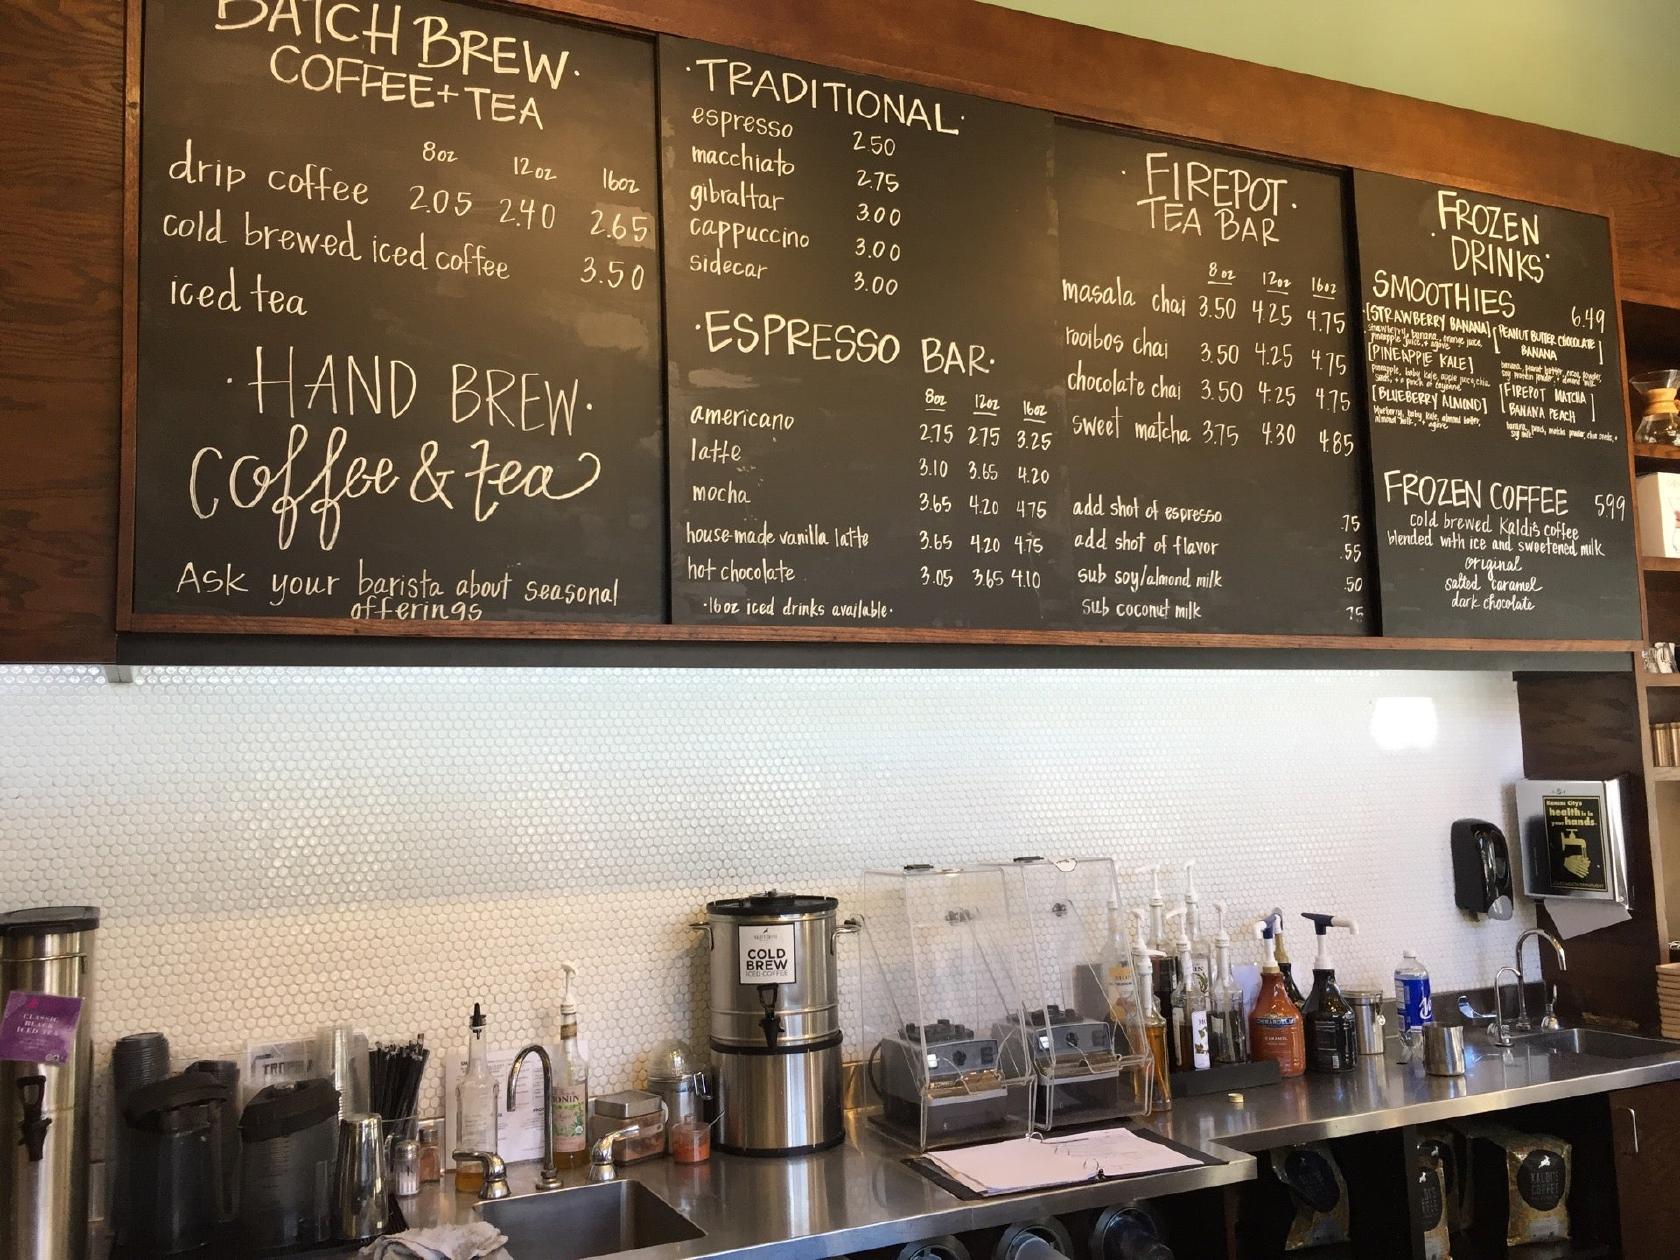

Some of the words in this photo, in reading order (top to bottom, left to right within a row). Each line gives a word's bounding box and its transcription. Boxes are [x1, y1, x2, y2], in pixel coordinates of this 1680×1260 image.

[413, 16, 569, 90] BREW
[465, 87, 543, 129] TEA
[696, 58, 959, 135] TRADITIONAL
[692, 106, 794, 138] espresso
[853, 131, 896, 157] 2.50
[422, 142, 458, 163] 8oz
[514, 157, 557, 180] 12oz
[603, 168, 640, 192] 16oz
[692, 142, 795, 177] macchiato
[857, 170, 900, 193] 2.75
[1146, 152, 1288, 216] FIREPOT
[168, 139, 246, 191] drip
[268, 164, 369, 204] coffee
[409, 185, 473, 216] 2.05
[499, 198, 556, 230] 2.40
[590, 210, 648, 242] 2.65
[689, 178, 785, 211] gibraltar
[856, 203, 901, 226] 3.00
[690, 216, 810, 249] cappuccino
[855, 238, 901, 262] 3.00
[1137, 196, 1202, 236] TEA
[1214, 208, 1279, 246] BAR
[1438, 190, 1539, 245] FROZEN
[163, 209, 226, 244] cold
[245, 211, 361, 261] brewed
[373, 233, 428, 270] iced
[436, 243, 510, 279] coffee
[580, 258, 645, 290] 3.50
[690, 248, 768, 280] sidecar
[853, 271, 898, 296] 3.00
[1451, 235, 1544, 284] DRINKS
[171, 267, 241, 312] iced
[250, 274, 307, 316] tea
[1062, 276, 1136, 307] masala
[1152, 284, 1186, 316] chai
[1199, 295, 1237, 319] 3.50
[1307, 309, 1345, 334] 4.75
[1372, 269, 1515, 318] SMOOTHIES
[1571, 306, 1605, 334] 6.49
[705, 310, 900, 364] ESPRESSO
[922, 338, 990, 376] BAR
[1066, 324, 1124, 352] rooibos
[1133, 326, 1168, 359] chai
[1201, 344, 1239, 365] 3.50
[1312, 349, 1346, 377] 4.75
[1530, 330, 1556, 346] BUTTER
[248, 346, 417, 418] HAND
[452, 363, 579, 436] BREW
[925, 388, 947, 406] 8oz
[1023, 400, 1047, 417] 16oz
[1068, 359, 1145, 396] chocolate
[1151, 374, 1181, 400] chai
[1200, 380, 1243, 403] 3.50
[690, 405, 794, 430] americano
[1016, 430, 1053, 451] 3.25
[1072, 406, 1123, 439] sweet
[1135, 411, 1192, 444] matcha
[1202, 420, 1239, 446] 3.75
[1319, 429, 1354, 457] 4.85
[410, 441, 455, 509] &
[691, 438, 742, 464] latte
[919, 457, 948, 478] 3.10
[1018, 466, 1050, 484] 4.20
[692, 480, 751, 504] mocha
[1072, 493, 1105, 516] add
[1110, 495, 1139, 519] shot
[1145, 499, 1159, 520] of
[1165, 505, 1222, 523] espresso
[1384, 469, 1481, 509] FROZEN
[1490, 482, 1568, 516] COFFEE
[779, 524, 829, 546] vanilla
[835, 525, 869, 548] latte
[1074, 527, 1107, 550] add
[1115, 530, 1146, 553] shot
[1153, 534, 1168, 554] of
[1173, 534, 1220, 555] flavor
[1387, 529, 1433, 546] blended
[1440, 534, 1465, 549] with
[1469, 536, 1487, 550] ice
[1492, 536, 1513, 551] and
[1518, 537, 1578, 556] sweetened
[1581, 538, 1605, 557] milk
[1410, 510, 1438, 529] cold
[1444, 514, 1492, 533] brewed
[1544, 520, 1579, 541] coffee
[176, 562, 248, 594] Ask
[269, 573, 340, 606] your
[358, 559, 445, 597] barista
[455, 569, 513, 600] about
[524, 578, 619, 606] seasonal
[687, 557, 717, 581] hot
[720, 559, 795, 583] chocolate
[920, 566, 953, 586] 3.05
[1078, 563, 1107, 584] sub
[1196, 569, 1223, 588] milk
[1445, 574, 1481, 591] salted
[1491, 576, 1543, 592] caramel
[1465, 555, 1522, 580] original
[350, 597, 483, 621] offerings
[746, 598, 774, 616] iced
[783, 598, 824, 617] drinks
[1081, 596, 1109, 616] sub
[1116, 597, 1169, 619] coconut
[1175, 601, 1202, 619] milk
[1451, 592, 1480, 608] dark
[1483, 595, 1535, 611] chocolate
[1549, 807, 1580, 816] health
[746, 959, 788, 971] BREW
[747, 948, 786, 960] COLD
